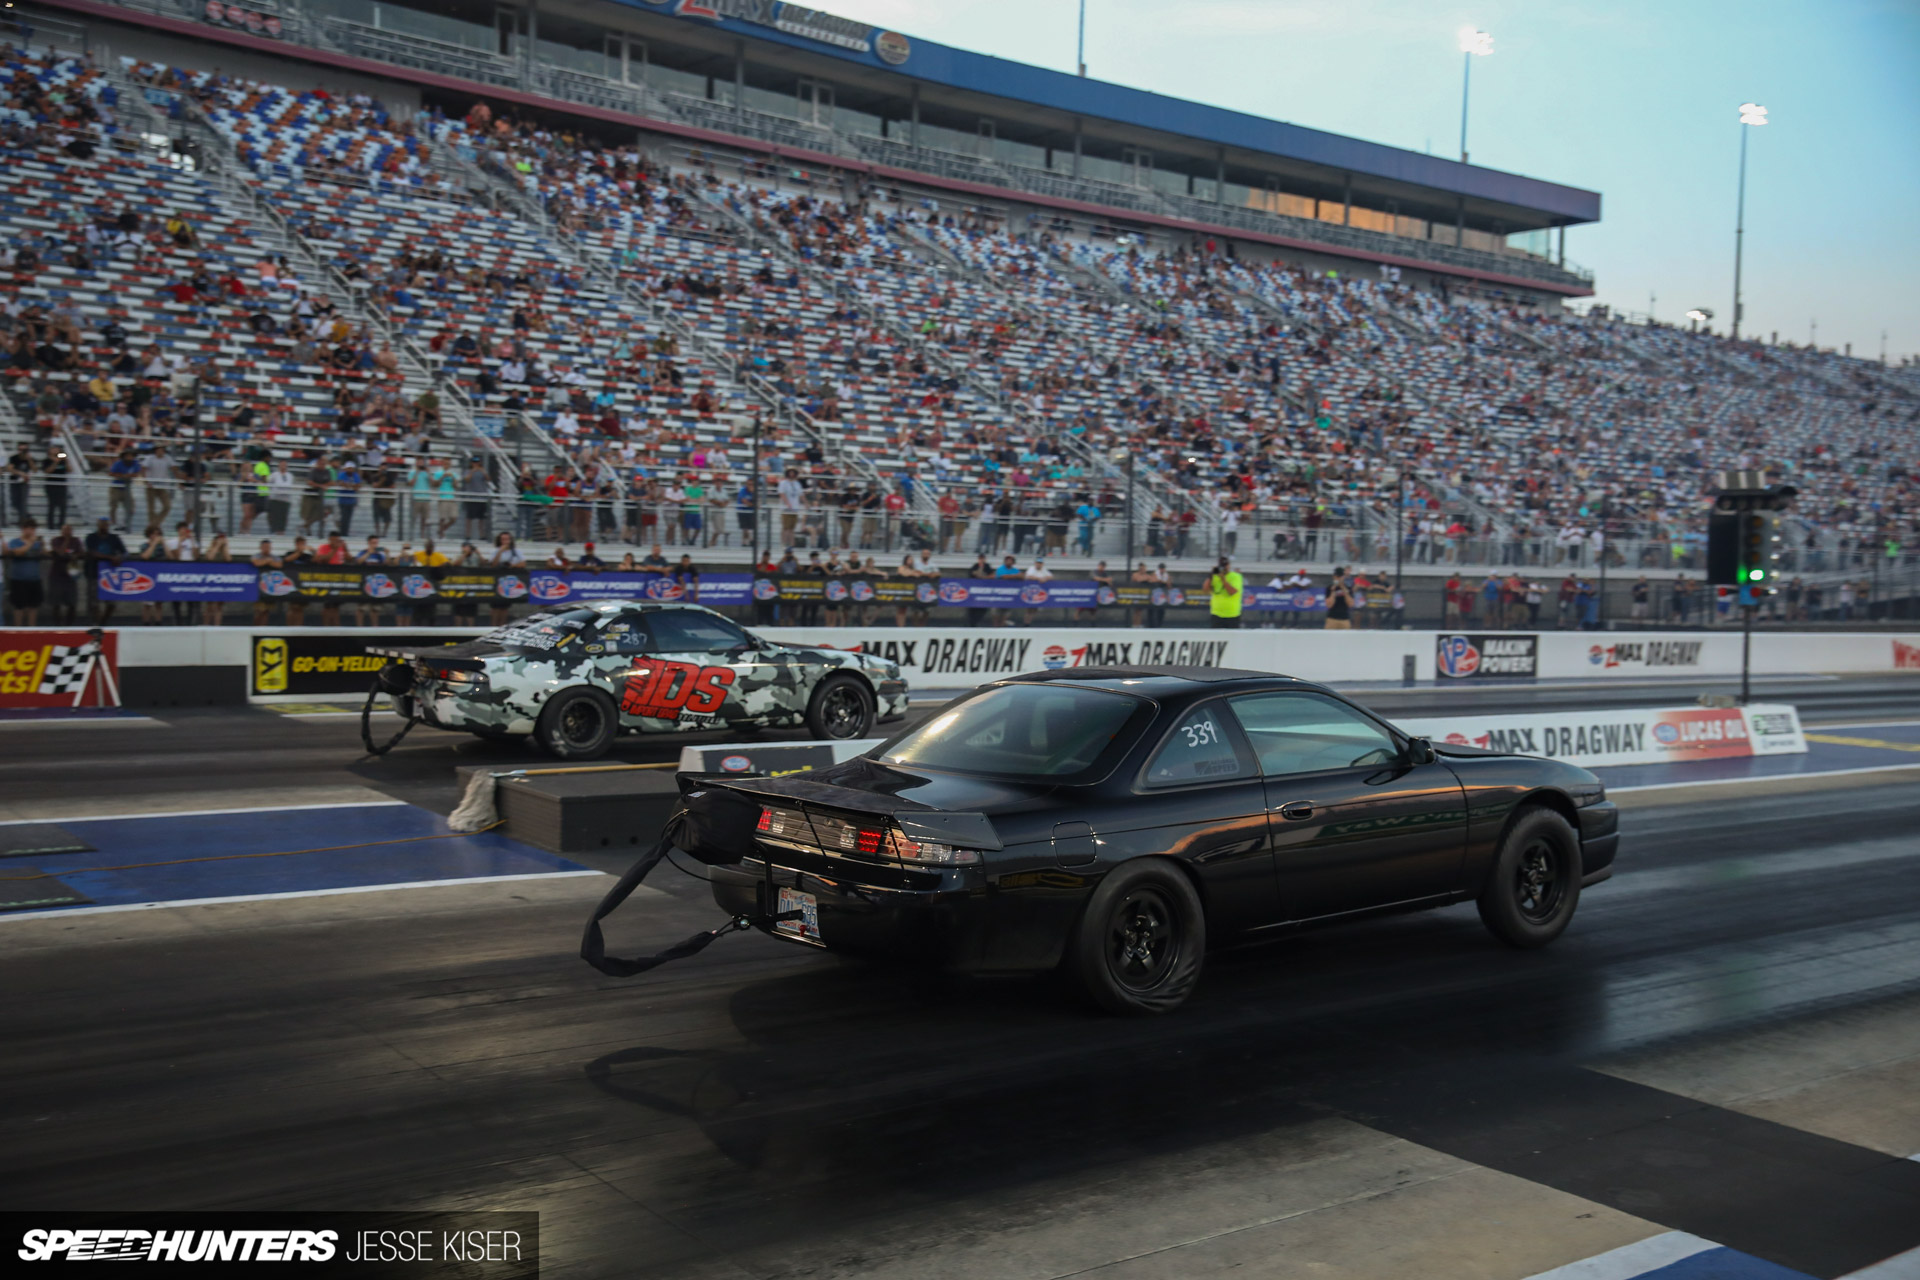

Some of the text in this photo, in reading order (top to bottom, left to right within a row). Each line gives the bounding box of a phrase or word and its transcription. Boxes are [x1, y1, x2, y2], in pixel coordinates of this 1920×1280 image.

[622, 633, 648, 646] 287
[0, 651, 37, 672] ce
[842, 638, 1032, 673] MAX DRAGWAY
[1138, 641, 1229, 667] DRAGWAY
[1645, 641, 1703, 666] DRAGWAY
[1181, 721, 1218, 748] 339
[1543, 723, 1646, 757] DRAGWAY
[1680, 719, 1723, 742] LUCAS
[1724, 718, 1748, 739] OIL
